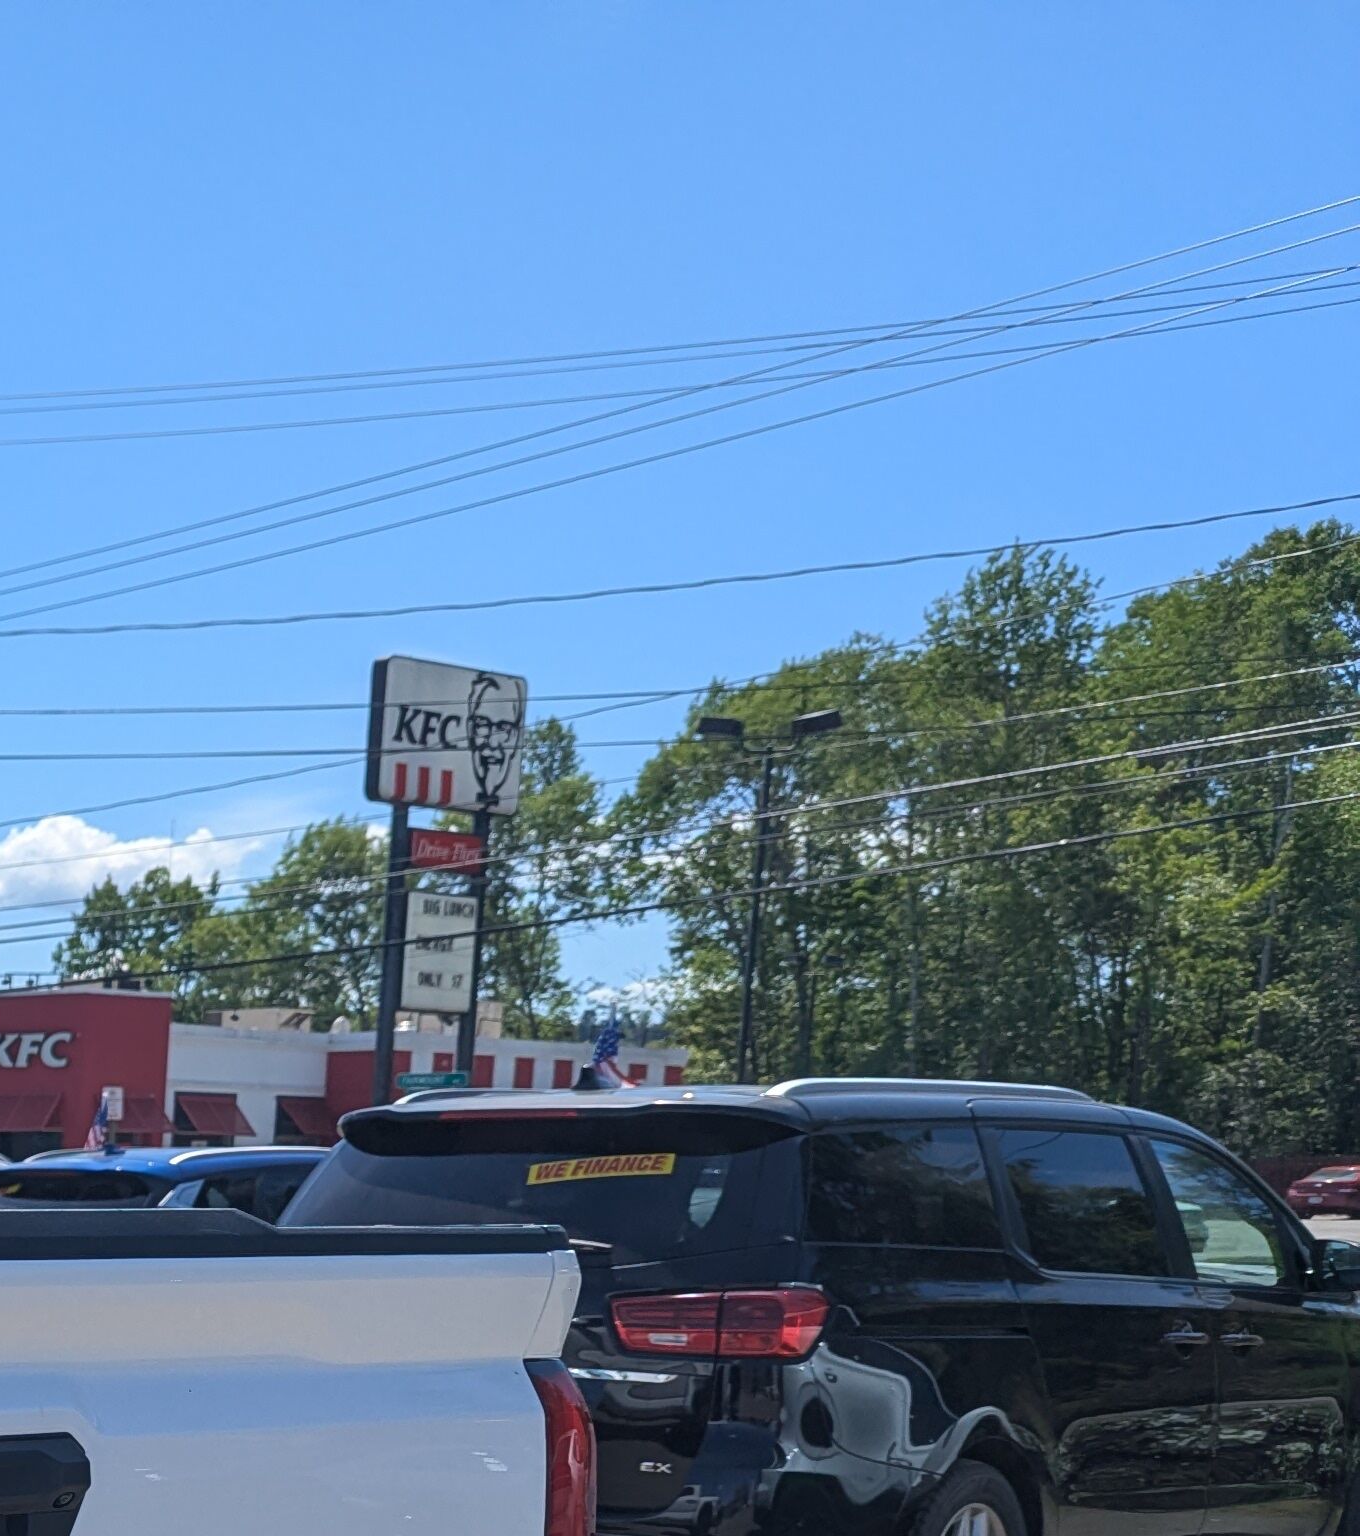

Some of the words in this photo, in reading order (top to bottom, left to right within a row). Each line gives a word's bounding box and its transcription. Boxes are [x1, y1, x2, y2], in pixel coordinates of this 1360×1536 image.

[392, 704, 461, 749] KFC
[535, 1162, 568, 1181] WE
[571, 1155, 668, 1176] FINANCE
[640, 1462, 672, 1474] EX
